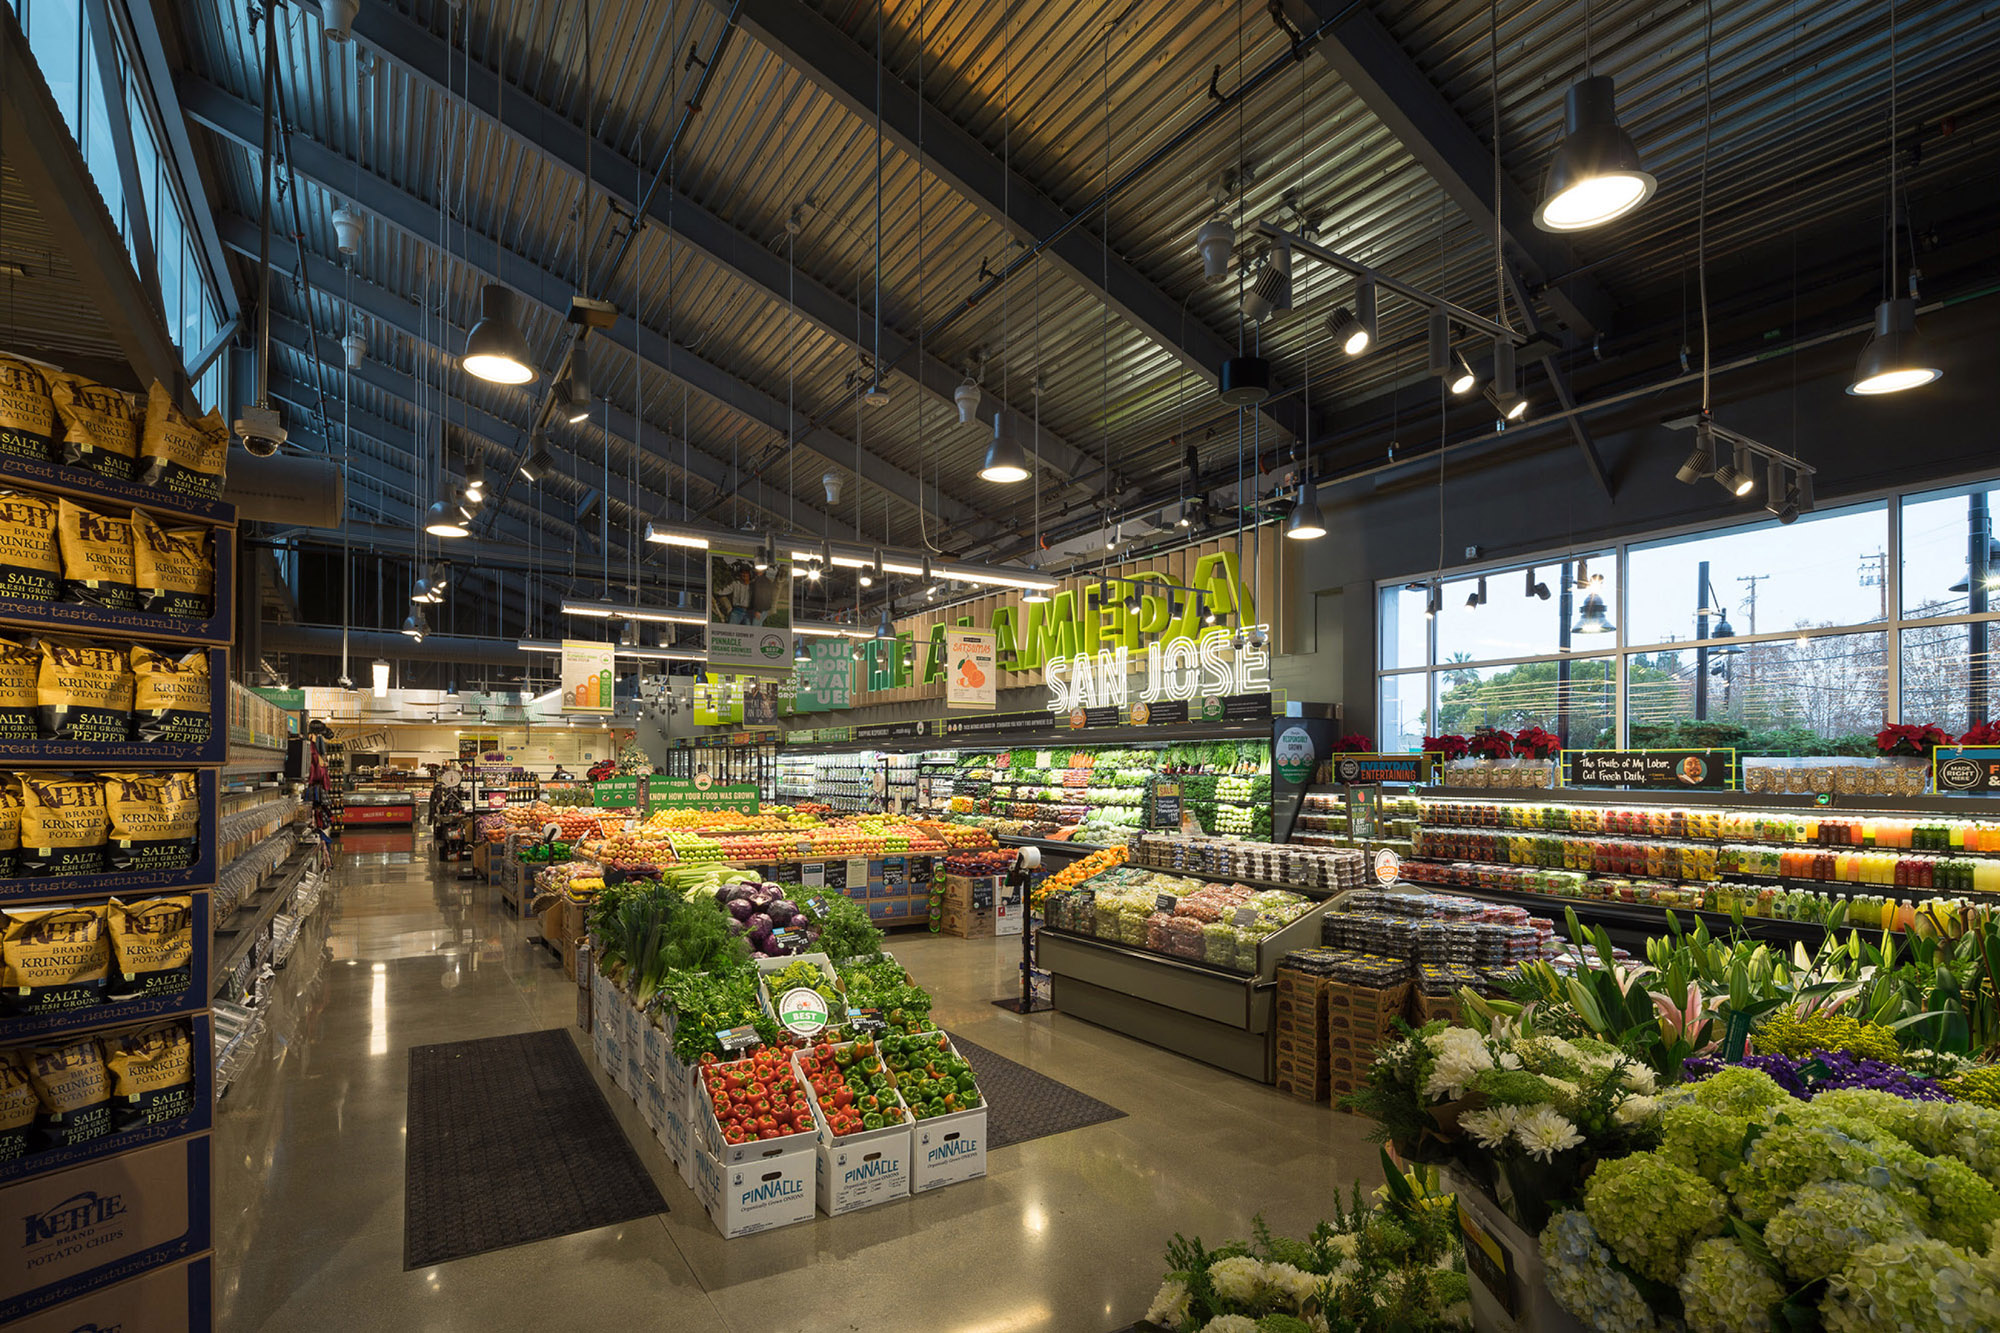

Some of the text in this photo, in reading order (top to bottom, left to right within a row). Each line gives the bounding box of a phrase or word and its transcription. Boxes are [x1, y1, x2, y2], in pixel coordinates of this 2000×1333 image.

[2, 432, 39, 451] SALT
[2, 459, 52, 478] great
[164, 476, 194, 489] FRESH
[177, 470, 209, 488] SALT
[8, 573, 45, 588] SALT
[174, 597, 200, 608] SALT
[164, 606, 186, 616] FRESH
[712, 637, 741, 646] PINNACLE
[848, 630, 914, 695] THE
[1045, 624, 1270, 713] SAN JOSE
[85, 671, 120, 682] BRAND
[58, 677, 116, 691] KRINKLE
[66, 689, 107, 700] POTATO
[79, 713, 122, 726] SALT &
[172, 716, 203, 726] SALT
[67, 723, 97, 732] FRESH
[72, 731, 126, 743] PEPPER
[343, 731, 388, 751] UALITY
[1282, 735, 1308, 743] RESPONSIBLY
[1288, 743, 1302, 751] GROWN
[1360, 761, 1416, 771] EVERYDAY
[1580, 757, 1595, 767] The
[1597, 756, 1620, 768] Fruits
[1622, 757, 1631, 769] of
[1632, 757, 1645, 771] My
[1360, 770, 1416, 780] ENTERTAINING
[1582, 769, 1596, 780] Cut
[1599, 769, 1621, 781] Fresh
[650, 791, 755, 801] KNOW HOW YOUR FOOD WAS GROWN
[1159, 785, 1174, 795] SALE
[65, 809, 103, 819] BRAND
[122, 811, 181, 824] KRINKLE
[42, 818, 101, 830] KRINKLE
[128, 823, 169, 833] POTATO
[49, 829, 91, 840] POTATO
[143, 845, 187, 856] SALT &
[63, 852, 95, 865] SALT
[130, 855, 157, 864] FRESH
[51, 864, 78, 873] FRESH
[53, 945, 93, 955] BRAND
[21, 953, 88, 969] KRINKLE
[132, 953, 170, 964] POTATO
[28, 967, 75, 978] POTATO
[146, 973, 188, 989] SALT &
[43, 990, 92, 1004] SALT &
[28, 1001, 60, 1012] FRESH
[793, 1013, 817, 1021] BEST
[129, 1057, 185, 1078] KRINKLE
[136, 1071, 175, 1086] POTATO
[153, 1090, 183, 1107] SALT
[141, 1103, 168, 1117] FRESH
[74, 1110, 102, 1127] SALT
[62, 1122, 91, 1137] FRESH
[928, 1139, 977, 1163] PINNACLE
[961, 1151, 978, 1161] ONIONS
[844, 1159, 899, 1184] PINNACLE
[881, 1171, 899, 1180] ONIONS
[741, 1179, 803, 1206] PINNACLE
[783, 1193, 804, 1204] ONIONS
[21, 1192, 127, 1248] KETTLE
[56, 1229, 95, 1247] BRAND
[27, 1230, 124, 1270] POTATO CHIPS
